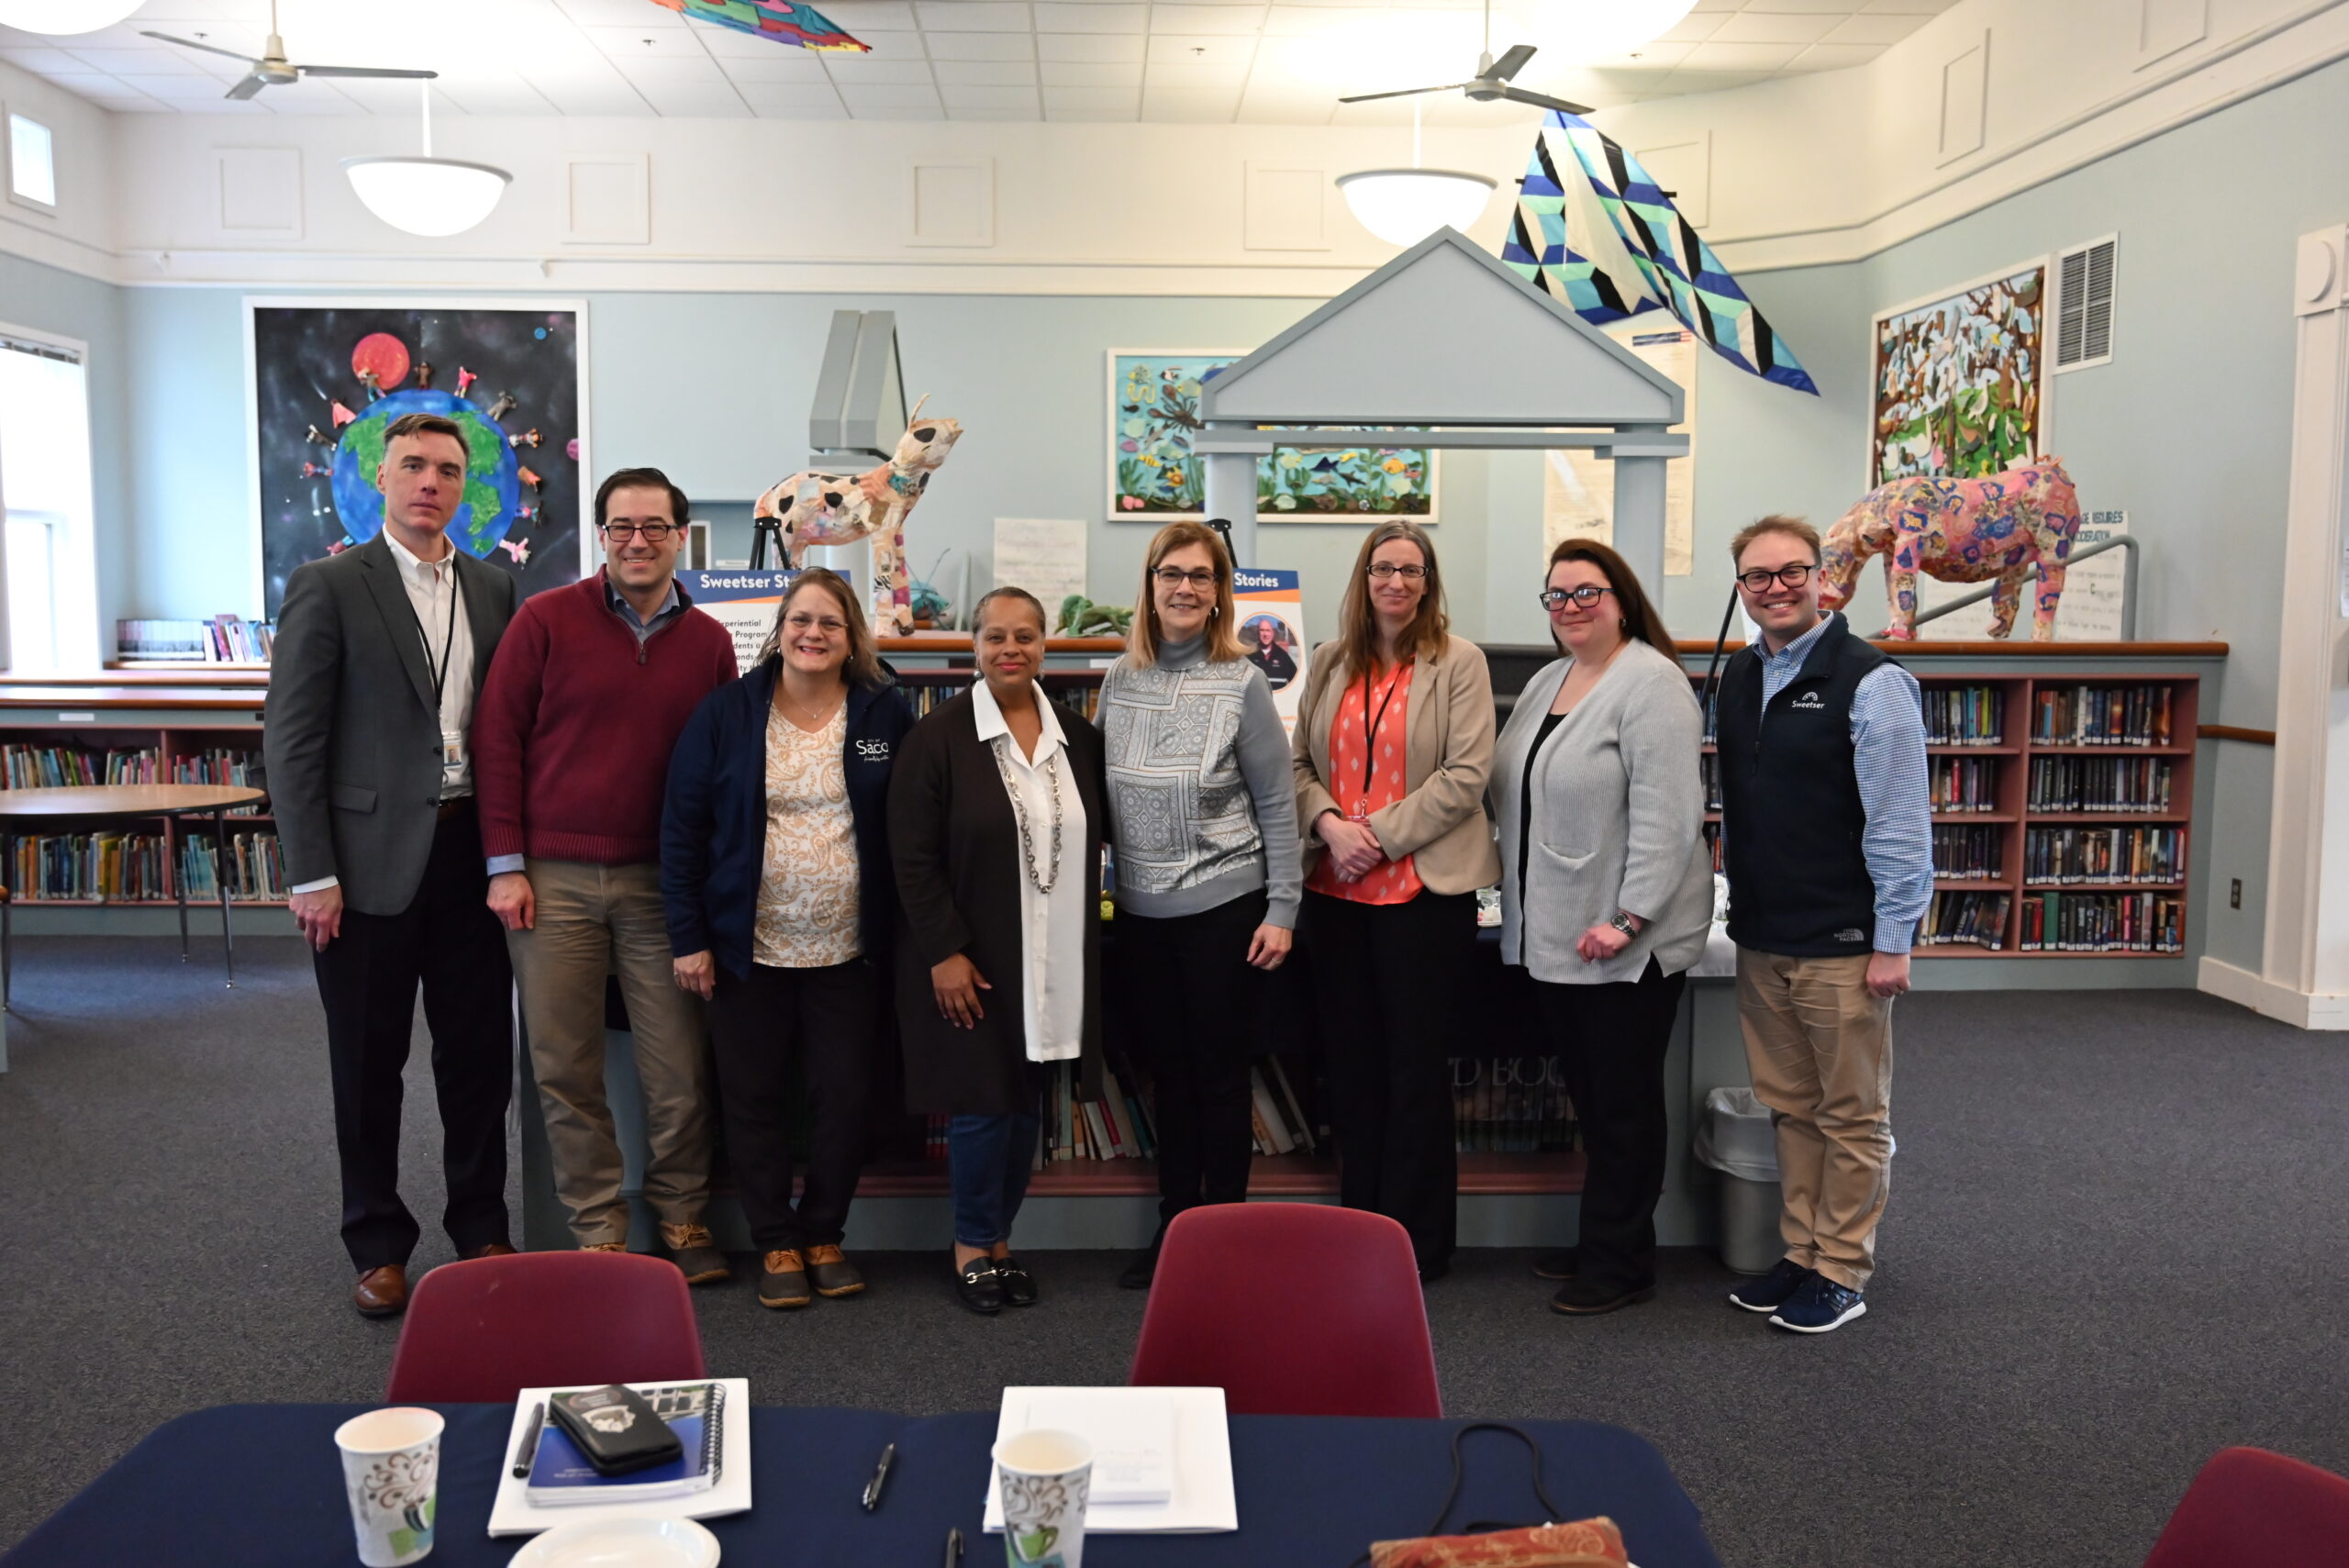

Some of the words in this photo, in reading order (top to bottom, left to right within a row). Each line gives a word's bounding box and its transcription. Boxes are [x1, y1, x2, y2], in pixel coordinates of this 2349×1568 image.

[700, 573, 771, 589] Sweetser
[1234, 573, 1279, 587] Stories
[1791, 700, 1825, 708] Sweetser
